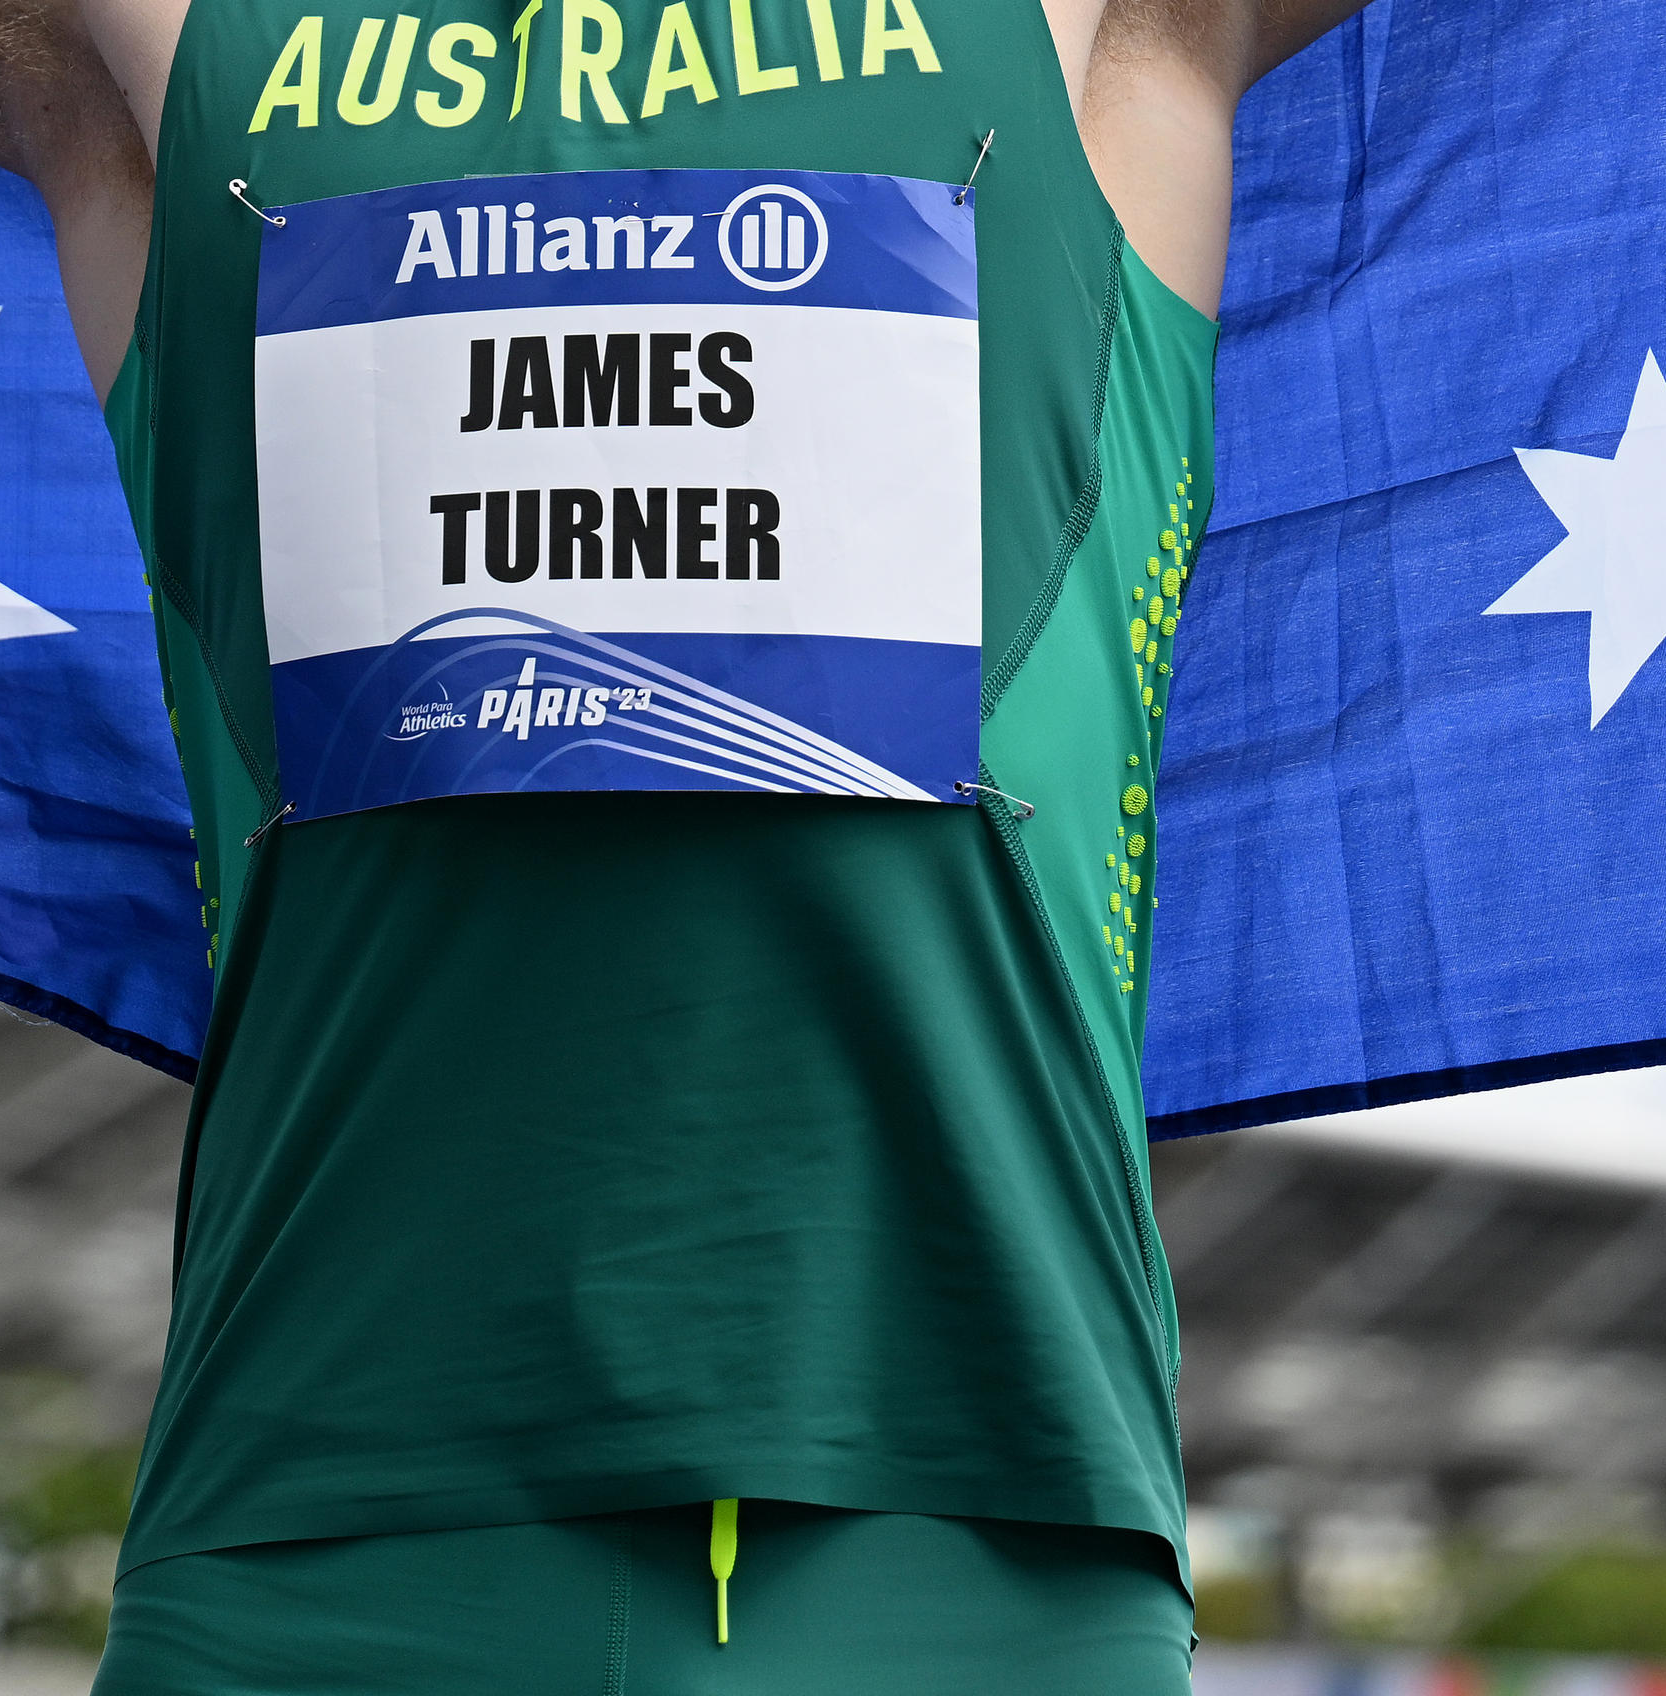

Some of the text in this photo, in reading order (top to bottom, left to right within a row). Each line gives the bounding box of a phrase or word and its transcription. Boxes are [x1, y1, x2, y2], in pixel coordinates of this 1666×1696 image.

[394, 204, 695, 284] Allianz
[460, 331, 755, 433] JAMES
[429, 487, 781, 586] TURNER
[399, 712, 467, 734] Athletics
[401, 701, 454, 717] World Para
[477, 657, 610, 741] PARIS
